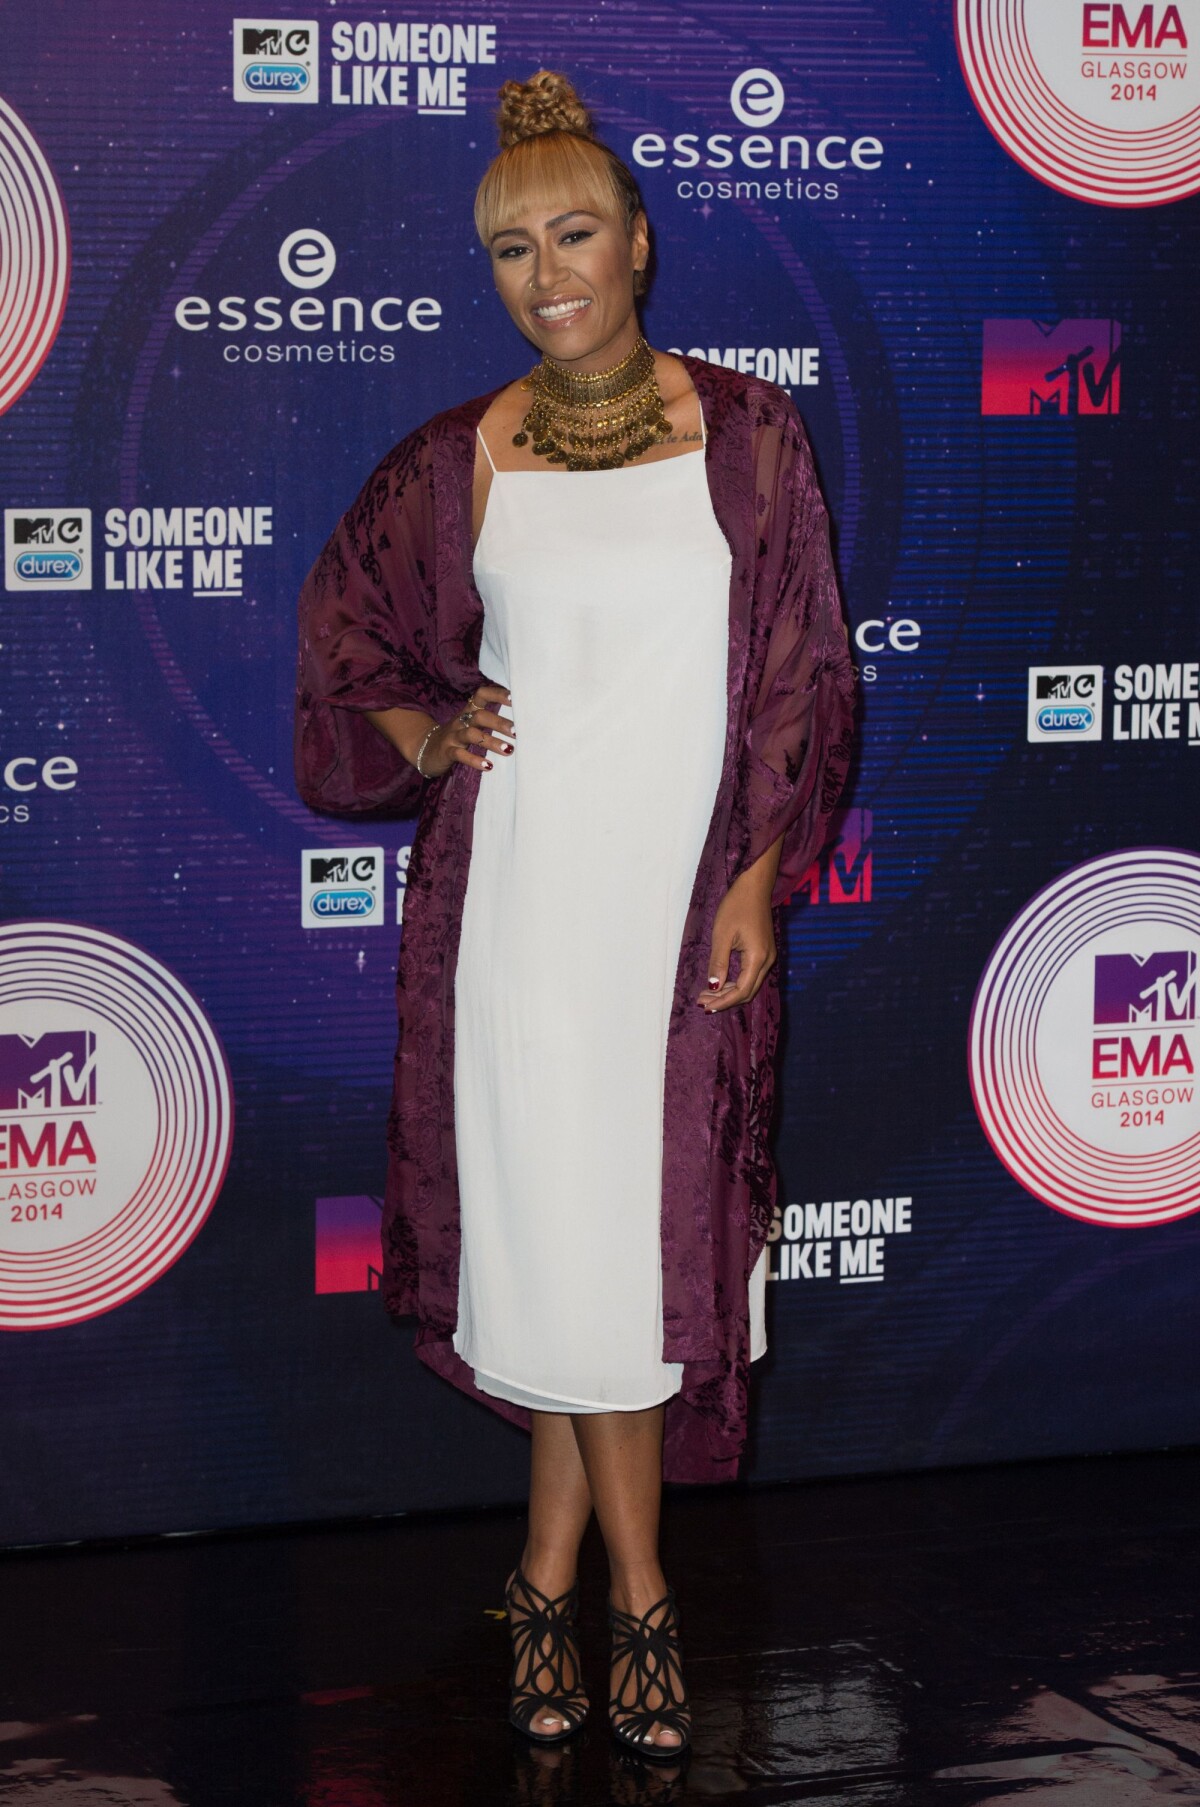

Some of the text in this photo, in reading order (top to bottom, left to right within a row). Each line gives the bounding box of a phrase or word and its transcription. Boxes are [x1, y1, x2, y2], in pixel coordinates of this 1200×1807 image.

[242, 28, 282, 55] MTV
[1082, 3, 1188, 49] EMA
[332, 21, 497, 64] SOMEONE
[248, 67, 304, 87] durex
[1080, 60, 1188, 79] GLASGOW
[332, 65, 467, 106] LIKE ME
[1110, 83, 1157, 101] 2014
[632, 133, 884, 170] essence
[677, 177, 839, 200] cosmetics
[174, 296, 442, 332] essence
[223, 340, 395, 363] cosmetics
[980, 318, 1121, 416] MTV
[13, 518, 54, 544] MTV
[104, 506, 273, 547] SOMEONE
[20, 556, 77, 575] durex
[105, 550, 243, 590] LIKE ME
[1036, 674, 1071, 699] MTV
[1113, 662, 1200, 701] SOME
[1041, 708, 1089, 728] durex
[1113, 702, 1181, 740] LIKE
[310, 857, 348, 884] MTV
[316, 893, 369, 912] durex
[1093, 951, 1197, 1026] MTV
[0, 1030, 97, 1111] MTV
[1092, 1033, 1195, 1080] EMA
[1091, 1087, 1195, 1109] GLASGOW
[1120, 1109, 1165, 1128] 2014
[0, 1120, 97, 1170] MA
[0, 1178, 97, 1201] ASGOW
[10, 1203, 63, 1222] 2014
[766, 1196, 912, 1242] SOMEONE
[765, 1237, 885, 1281] LIKE ME
